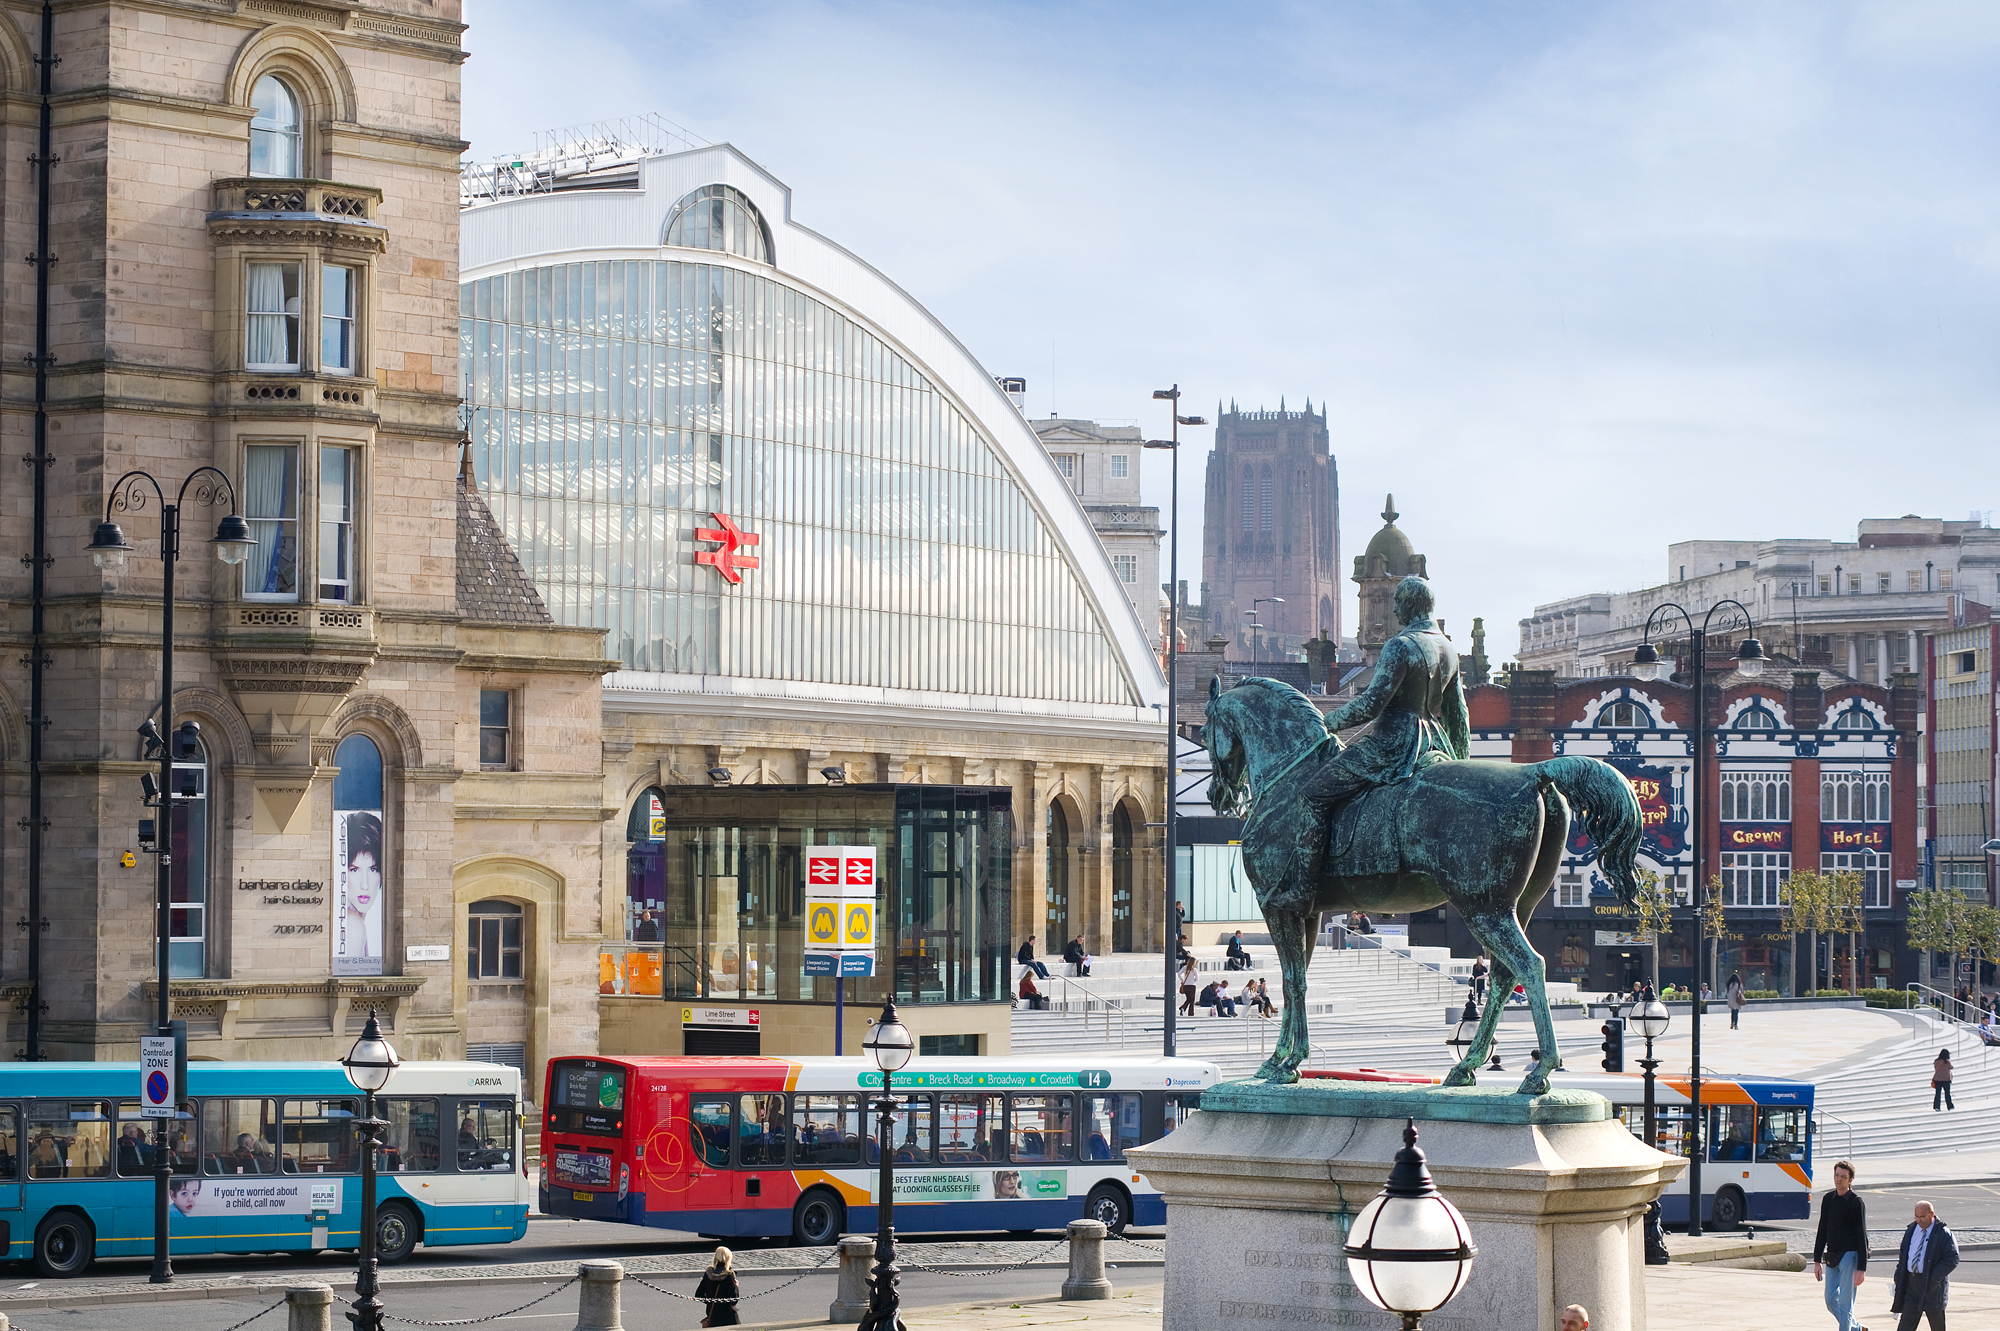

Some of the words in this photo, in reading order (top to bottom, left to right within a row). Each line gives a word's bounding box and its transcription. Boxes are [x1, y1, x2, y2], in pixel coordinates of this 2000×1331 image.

[338, 814, 347, 867] daley
[1732, 830, 1782, 844] CROWN
[1833, 830, 1883, 845] HOTEL
[239, 879, 290, 891] barbara
[291, 879, 324, 893] daley
[263, 895, 281, 904] hair
[282, 895, 290, 904] &
[292, 895, 324, 906] beauty
[338, 871, 347, 955] barbara
[274, 924, 295, 935] 709
[296, 924, 323, 935] 7974
[1728, 933, 1745, 941] THE
[411, 949, 423, 957] LIME
[425, 949, 444, 957] STREET
[359, 957, 381, 965] Beauty
[705, 1010, 718, 1018] Lime
[150, 1040, 165, 1048] Inner
[143, 1048, 173, 1056] Controlled
[147, 1058, 169, 1068] ZONE
[474, 1078, 502, 1086] ARRIVA
[865, 1074, 882, 1087] City
[890, 1075, 912, 1085] entre
[929, 1074, 951, 1085] Breck
[953, 1074, 974, 1085] Road
[987, 1074, 1026, 1087] Broadway
[1040, 1073, 1074, 1085] Croxteth
[1088, 1072, 1100, 1087] 14
[1172, 1078, 1201, 1087] Stagecoach
[895, 1175, 912, 1183] BEST
[914, 1175, 931, 1183] EVER
[932, 1175, 947, 1183] NHS
[948, 1175, 970, 1183] DEALS
[214, 1187, 220, 1197] If
[221, 1187, 245, 1199] you're
[246, 1187, 275, 1197] worried
[276, 1186, 298, 1196] about
[893, 1185, 932, 1194] AT-LOOKING
[935, 1185, 963, 1193] GLASSES
[964, 1184, 981, 1193] FREE
[232, 1198, 252, 1209] child,
[254, 1198, 268, 1208] call
[269, 1199, 286, 1207] now
[1329, 1284, 1359, 1297] EREC
